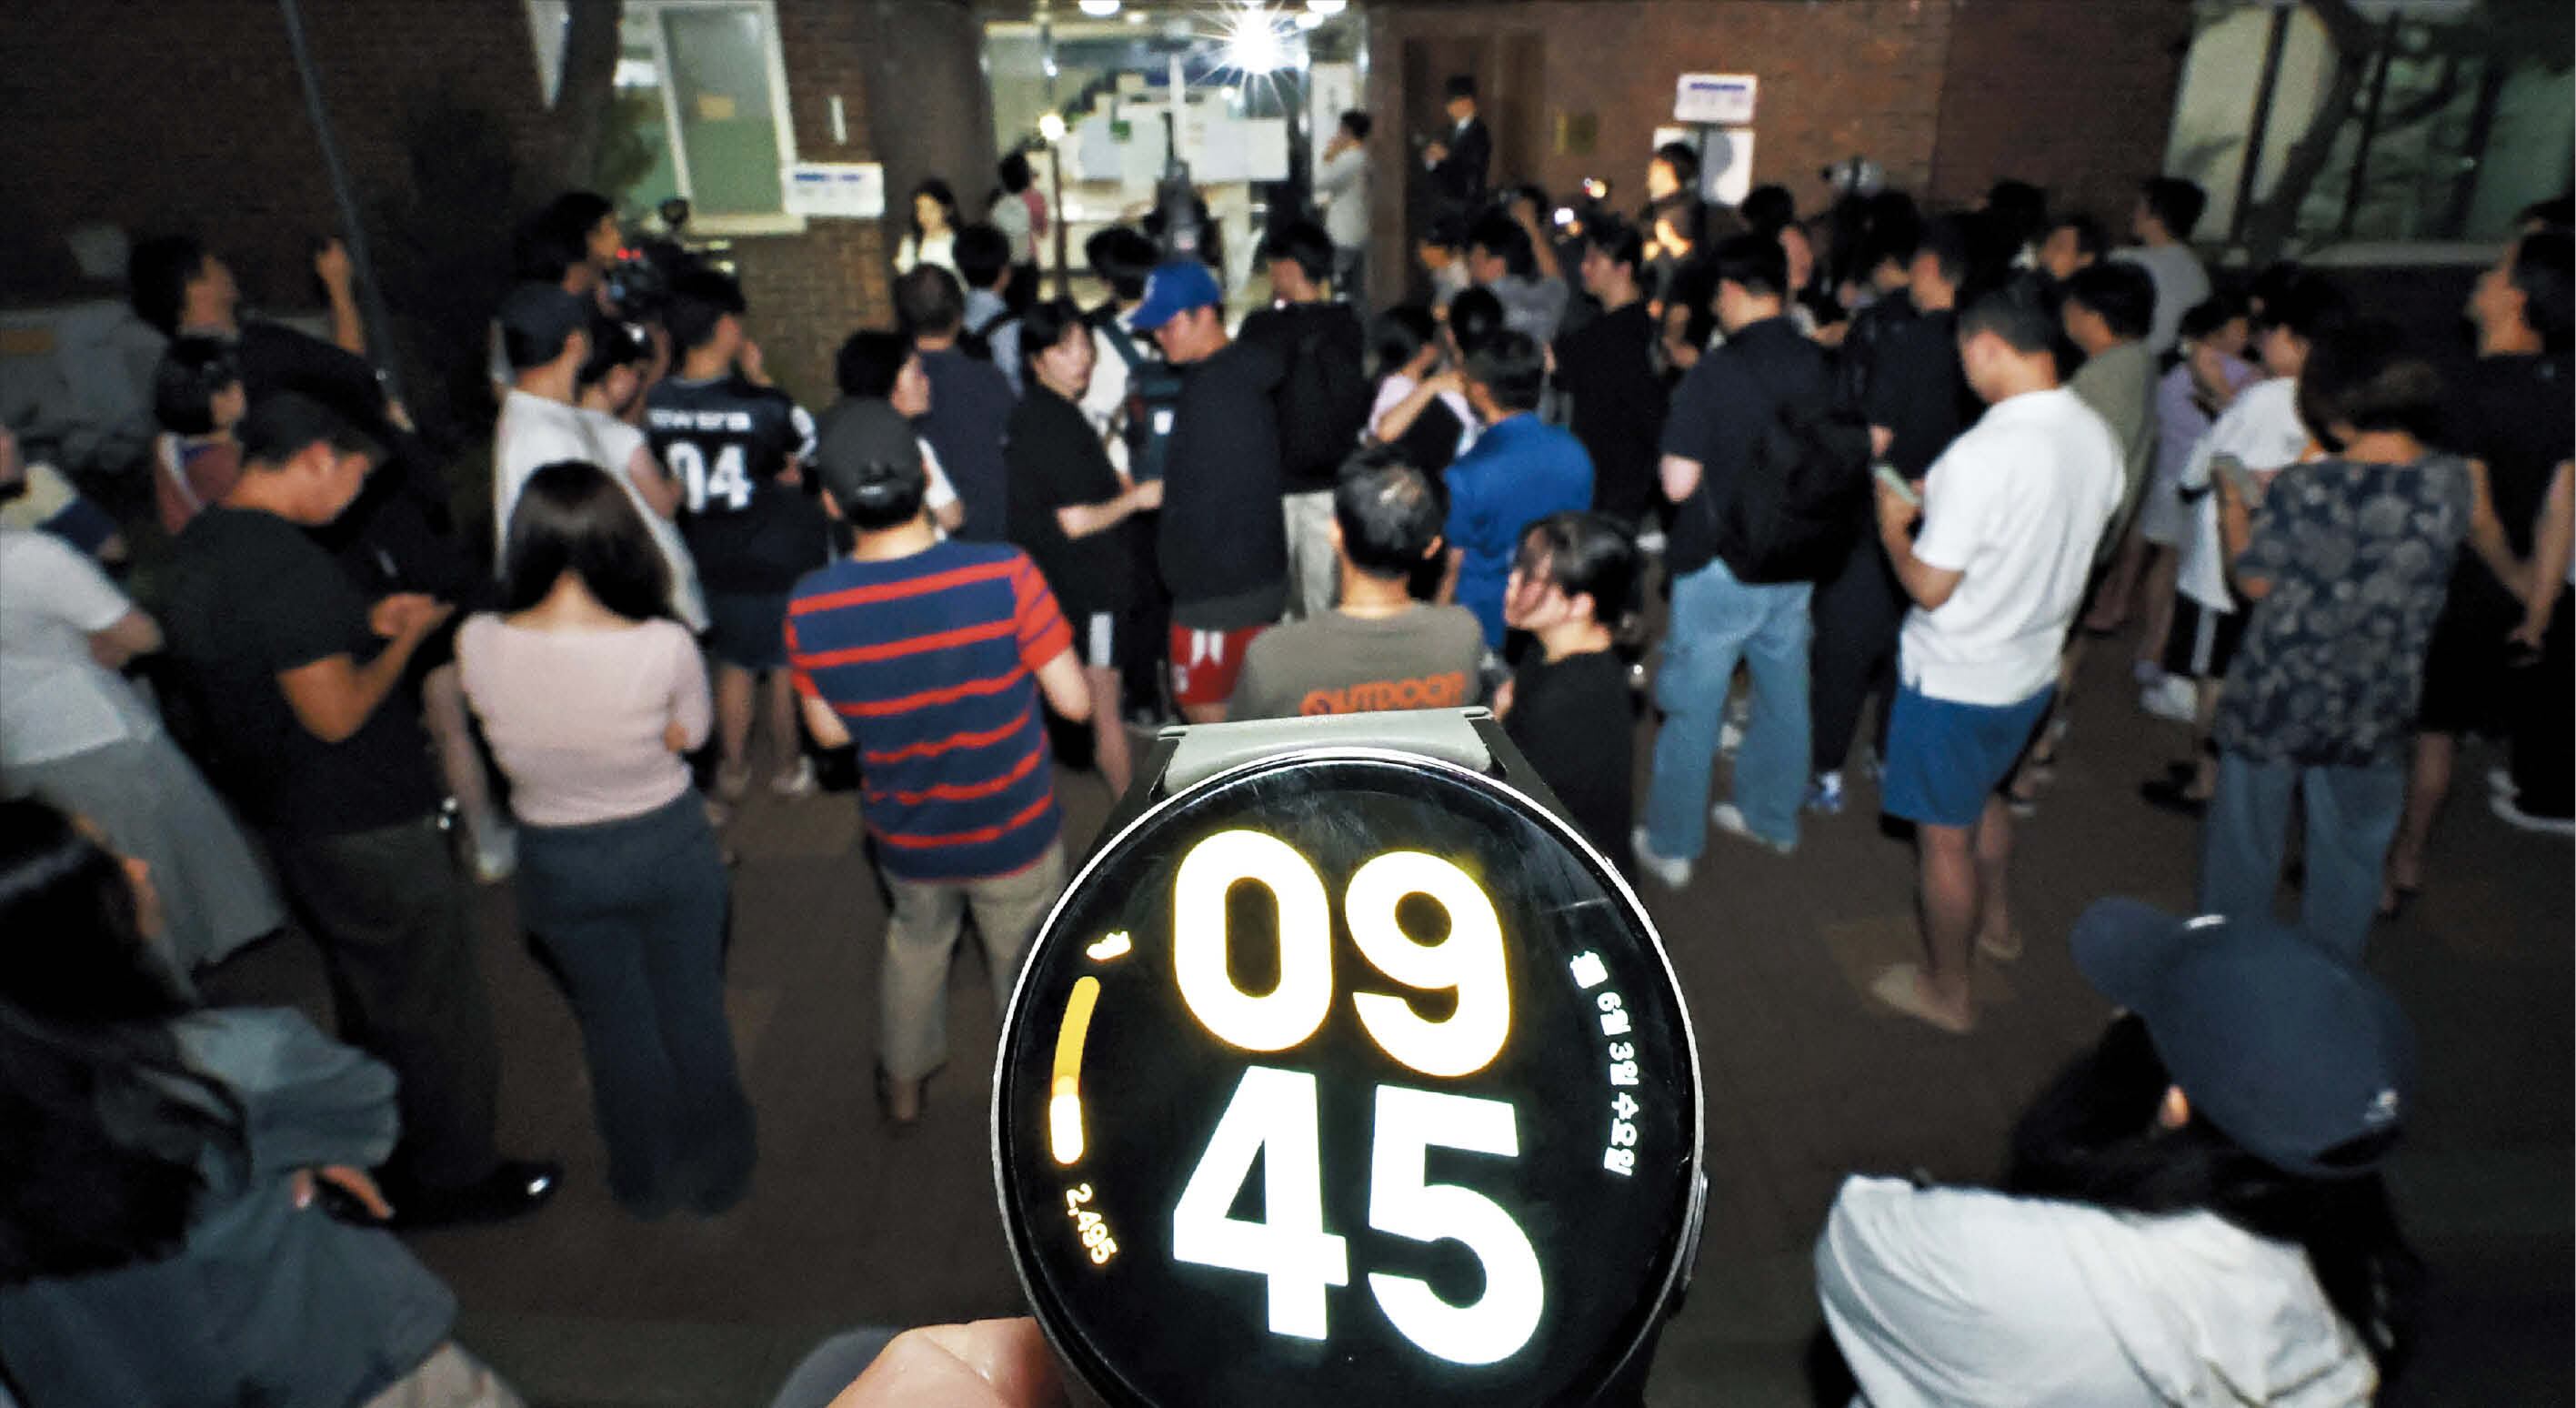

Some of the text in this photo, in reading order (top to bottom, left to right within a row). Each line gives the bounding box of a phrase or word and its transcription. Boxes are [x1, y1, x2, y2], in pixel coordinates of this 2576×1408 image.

[1173, 829, 1512, 1078] 09
[1597, 991, 1639, 1177] 6월 3일 수요일
[1066, 1182, 1118, 1265] 2,495
[1173, 1065, 1545, 1367] 45
